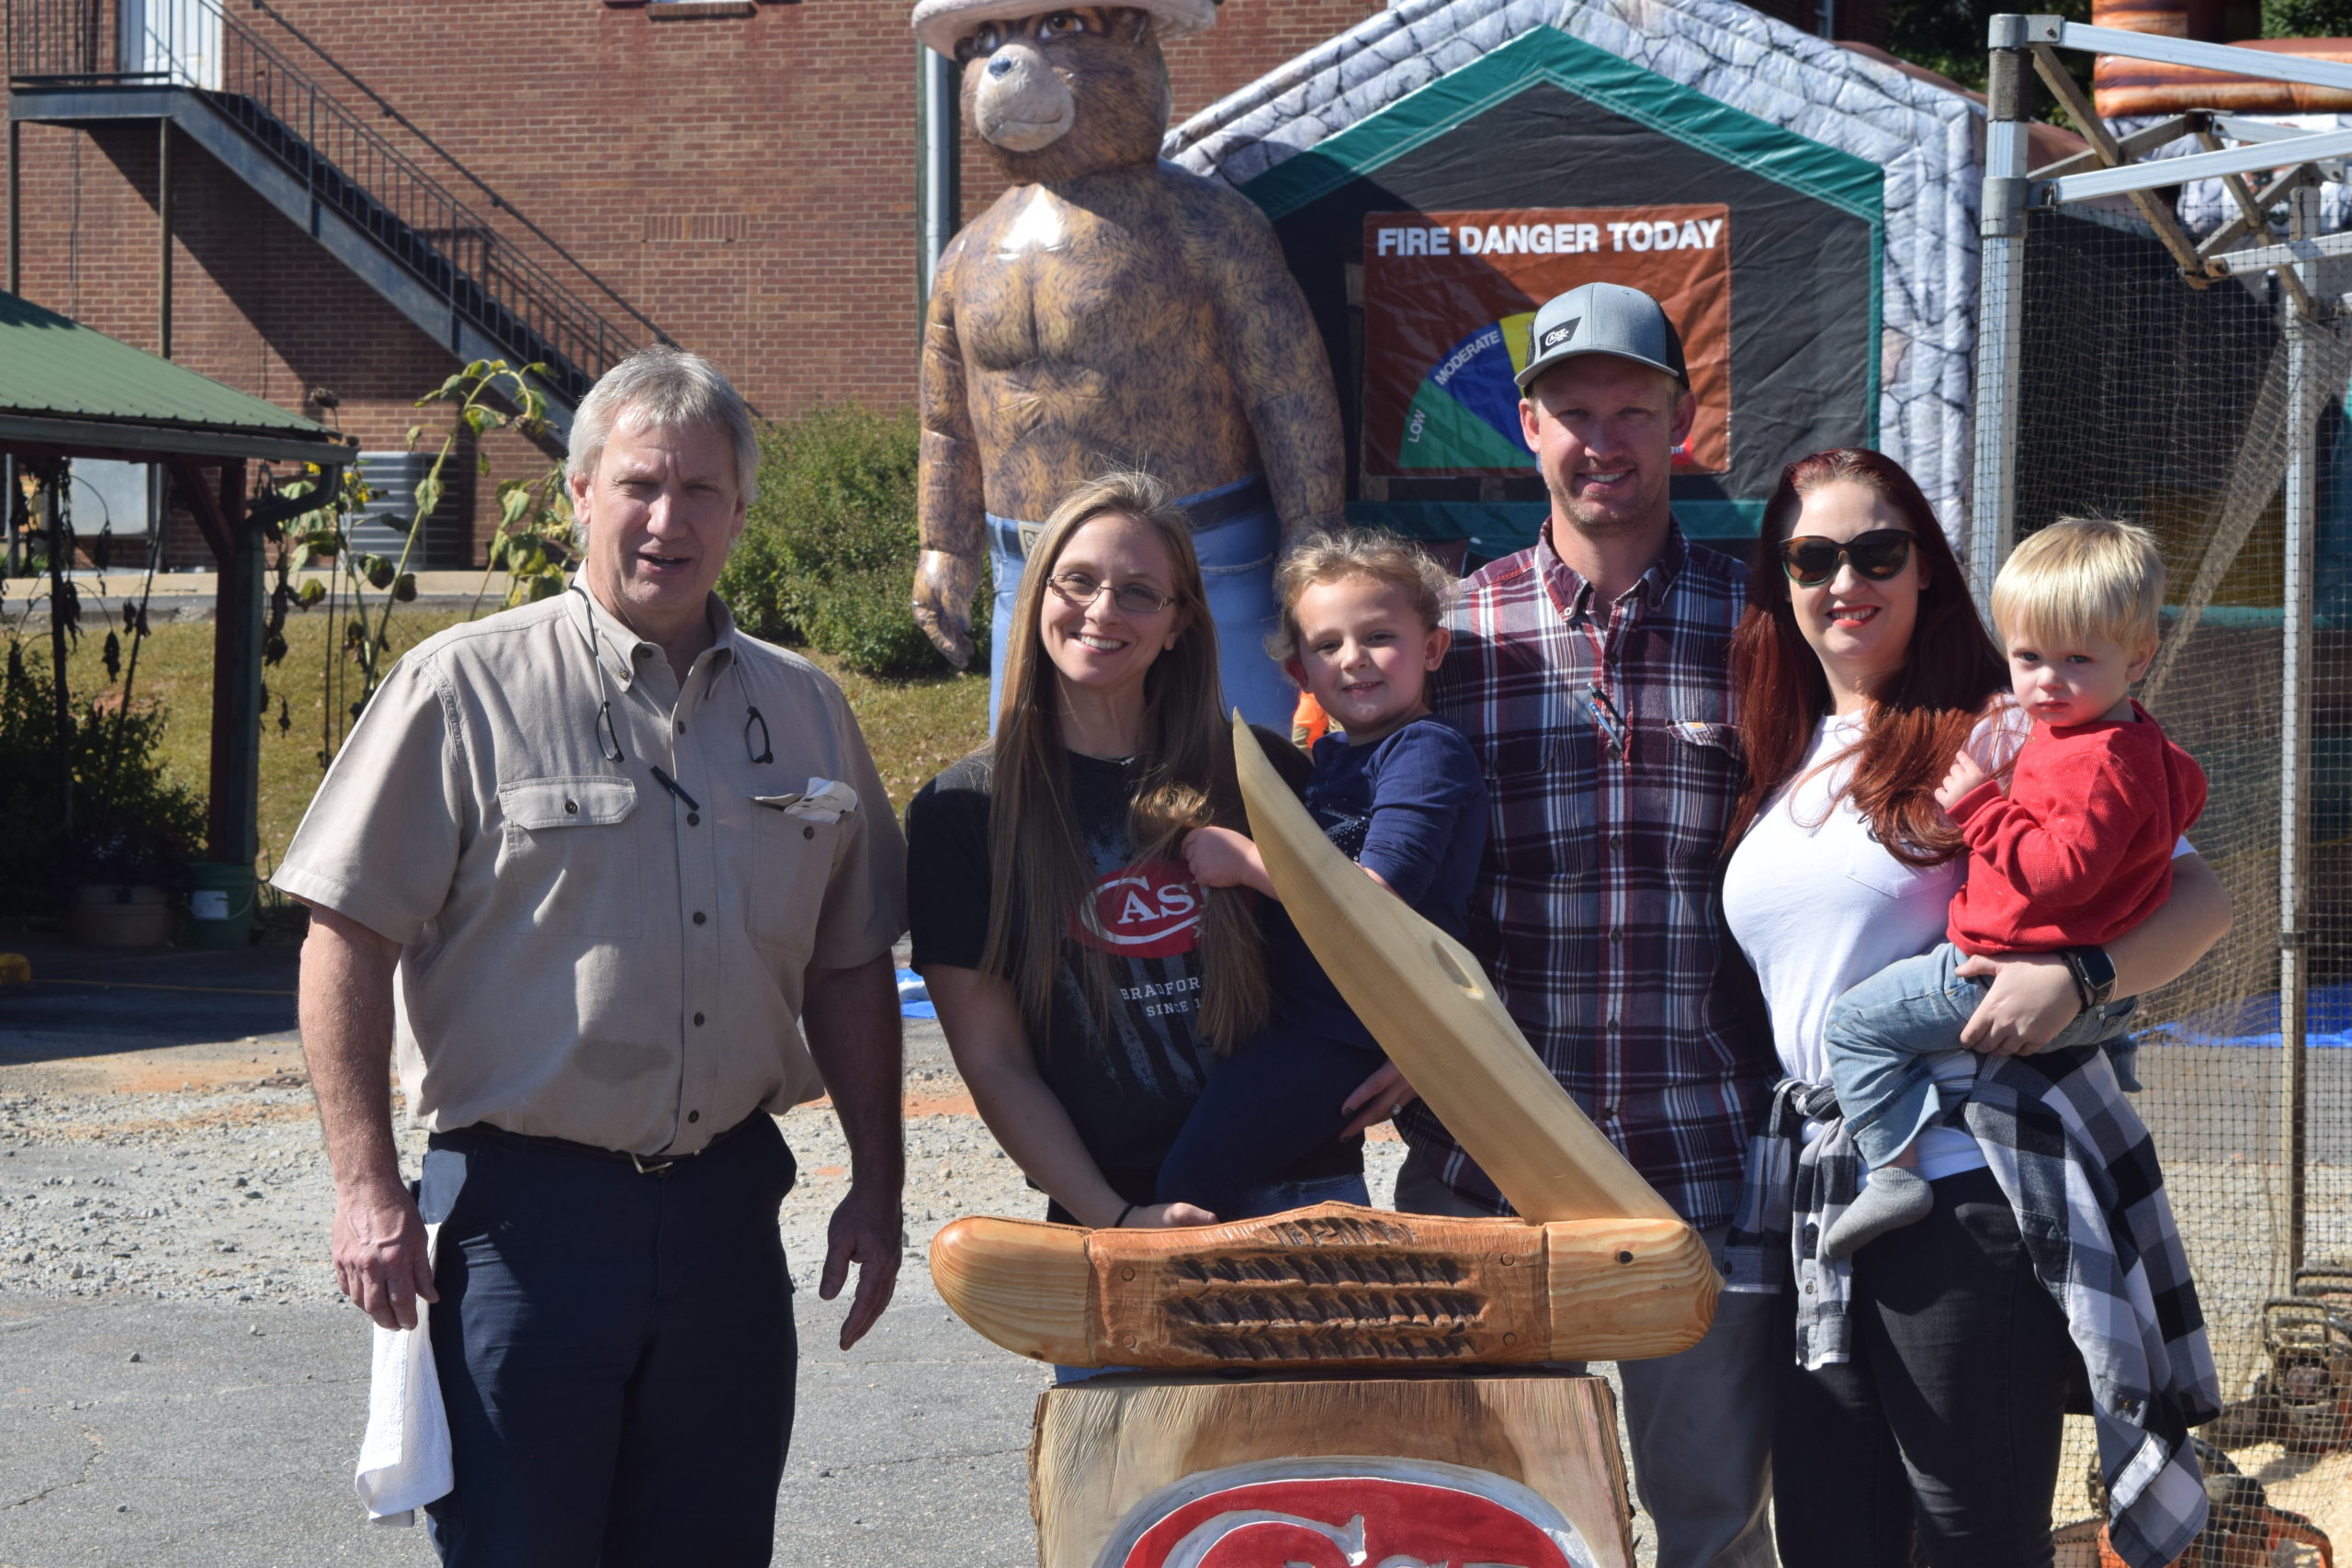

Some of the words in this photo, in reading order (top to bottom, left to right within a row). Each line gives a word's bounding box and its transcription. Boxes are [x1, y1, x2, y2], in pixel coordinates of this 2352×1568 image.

[1378, 228, 1450, 255] FIRE
[1459, 223, 1599, 254] DANGER
[1609, 220, 1723, 251] TODAY
[1434, 331, 1500, 385] MODERATE
[1408, 409, 1426, 443] LOW
[1120, 976, 1202, 1000] BRADFOR
[1146, 1002, 1189, 1017] SINCE
